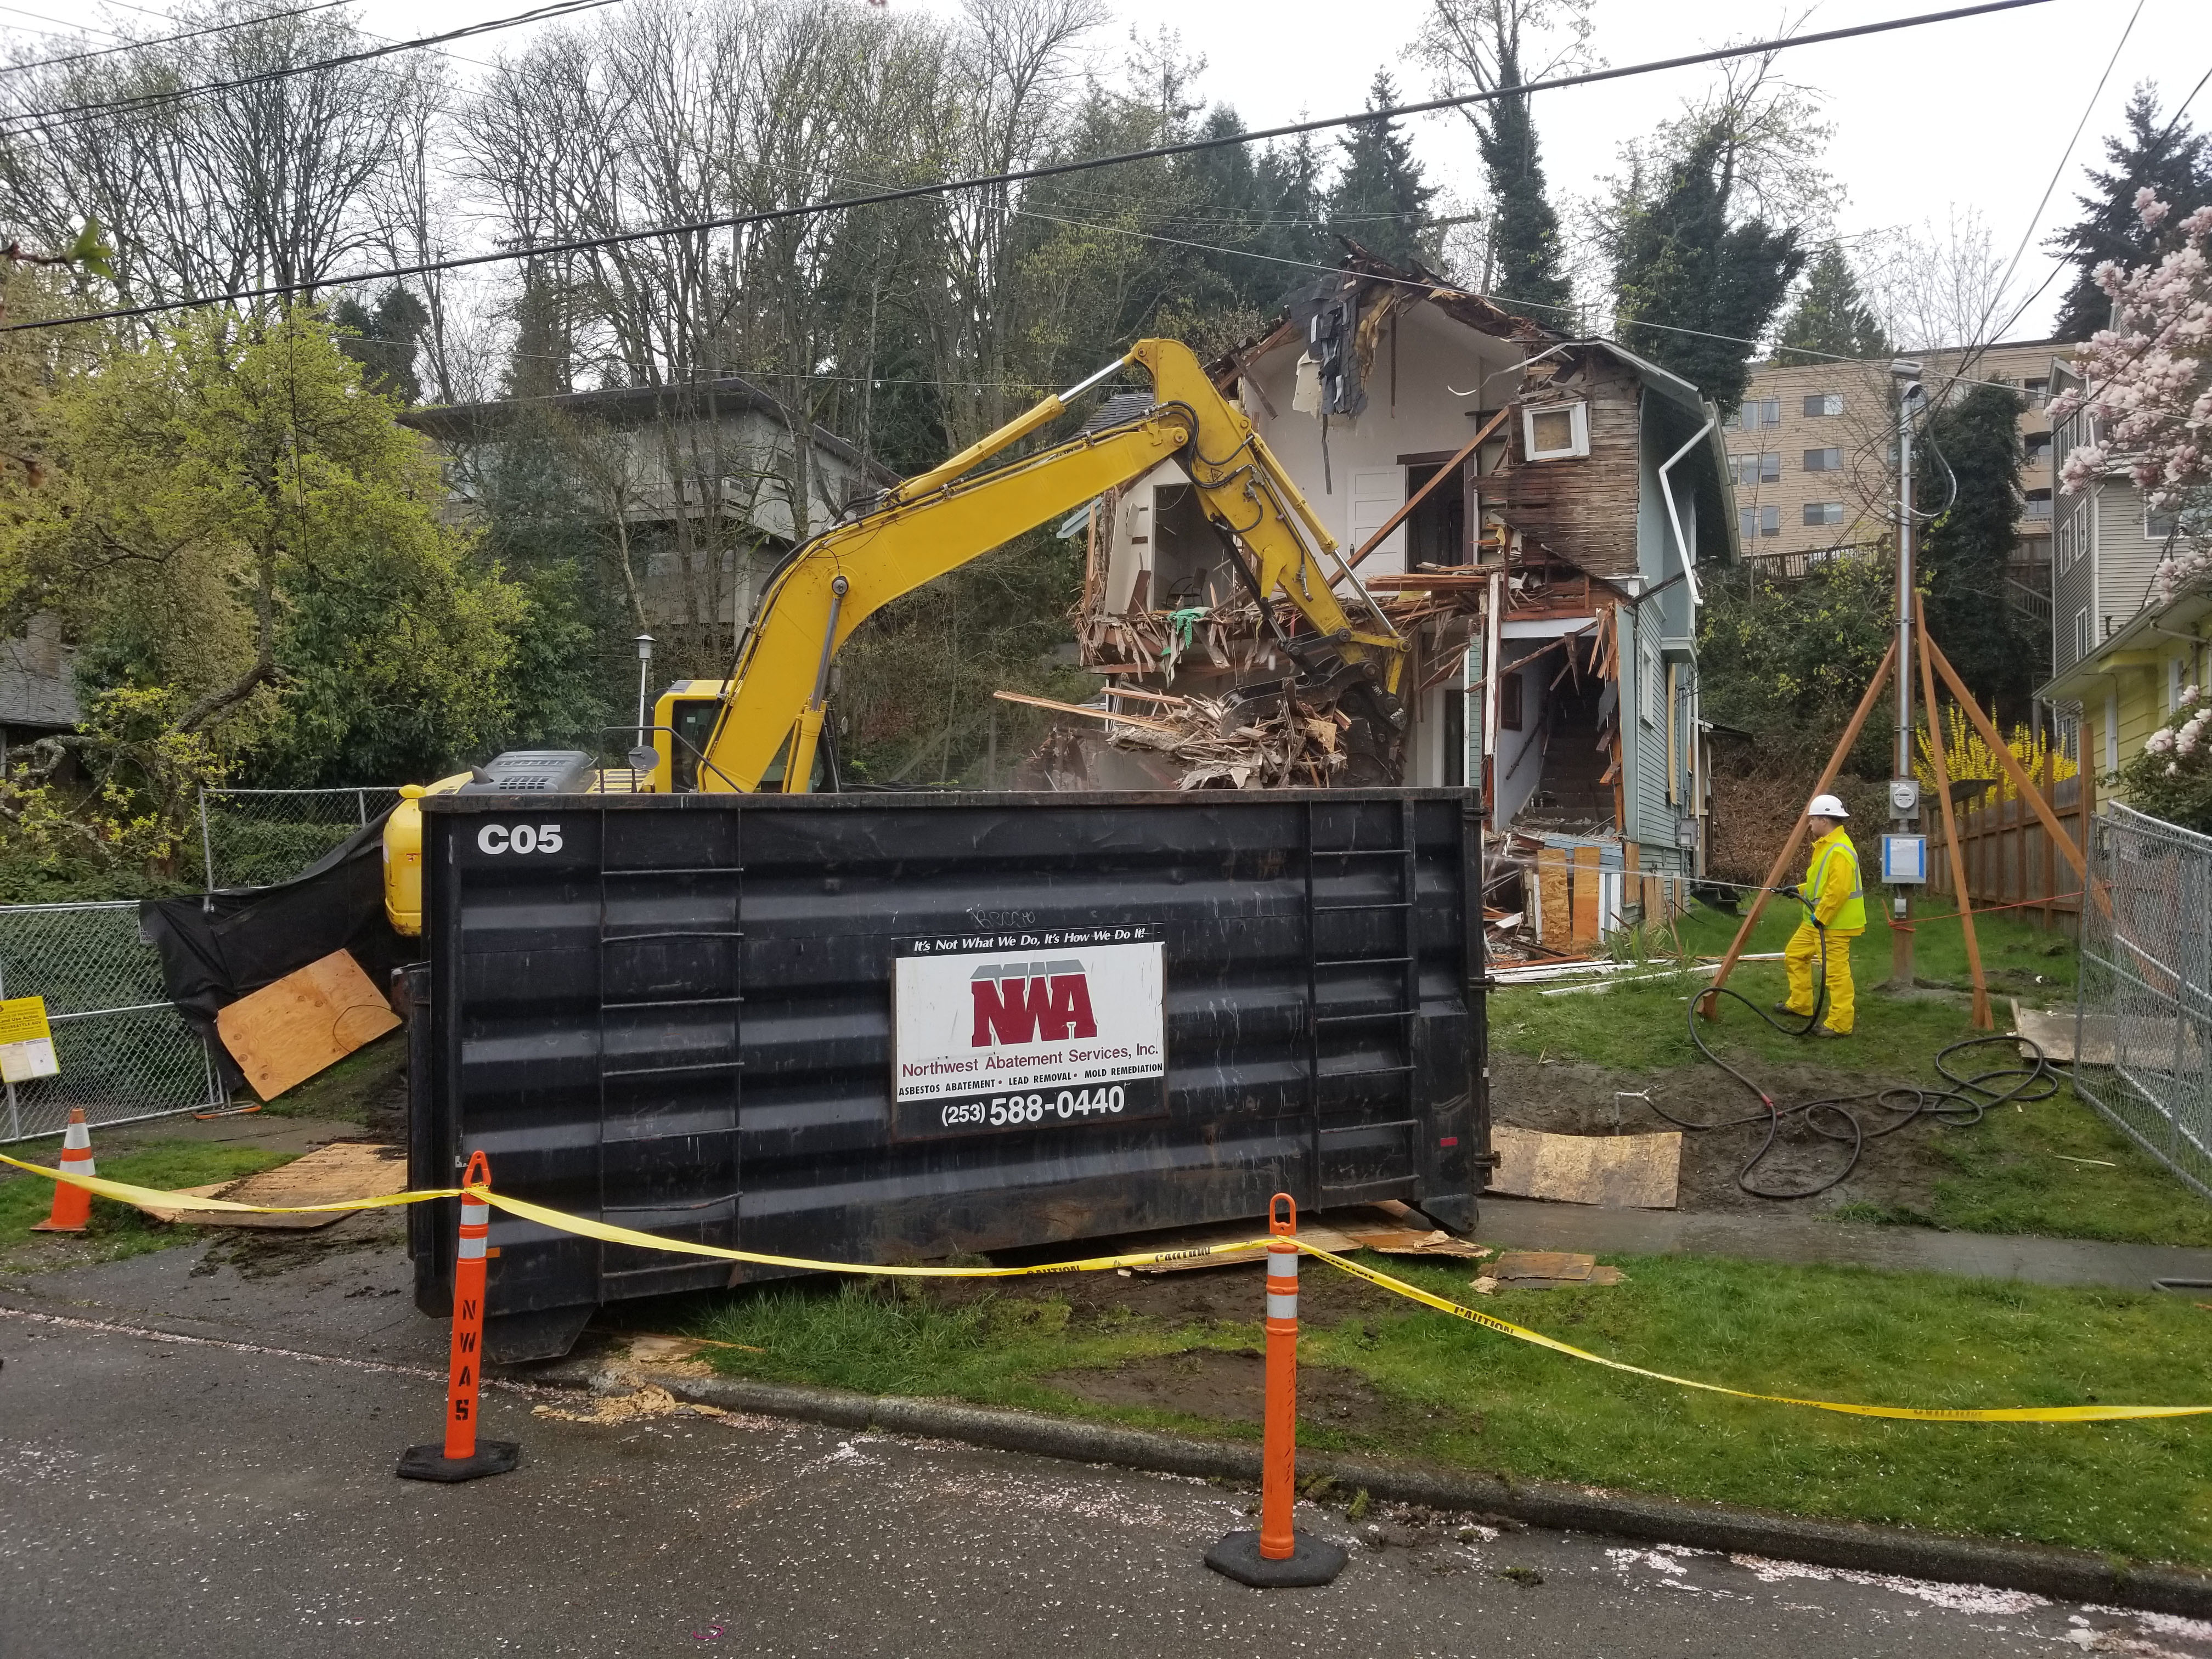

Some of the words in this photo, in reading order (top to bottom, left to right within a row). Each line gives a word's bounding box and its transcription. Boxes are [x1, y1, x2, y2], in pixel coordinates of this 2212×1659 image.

[477, 824, 563, 855] C05
[914, 940, 931, 952] It's
[935, 939, 958, 950] Not
[962, 938, 994, 949] What
[998, 936, 1017, 947] We
[1020, 935, 1041, 947] Do,
[1045, 933, 1060, 944] It's
[1064, 932, 1091, 943] How
[1094, 930, 1111, 941] We
[1114, 929, 1131, 940] Do
[1134, 928, 1146, 939] It!
[971, 972, 1098, 1048] NWA
[902, 1058, 979, 1077] Northwest
[985, 1051, 1063, 1070] Abatement
[1069, 1046, 1132, 1063] Services,
[1137, 1043, 1159, 1056] Inc.
[899, 1084, 940, 1096] ASBESTOS
[945, 1079, 996, 1091] ABATEMENT
[1009, 1076, 1029, 1086] LEAD
[1034, 1072, 1071, 1084] REMOVAL
[1084, 1069, 1107, 1079] MOLD
[1111, 1063, 1163, 1076] REMEDIATION
[941, 1102, 986, 1127] (253)
[990, 1086, 1125, 1125] 588-0440
